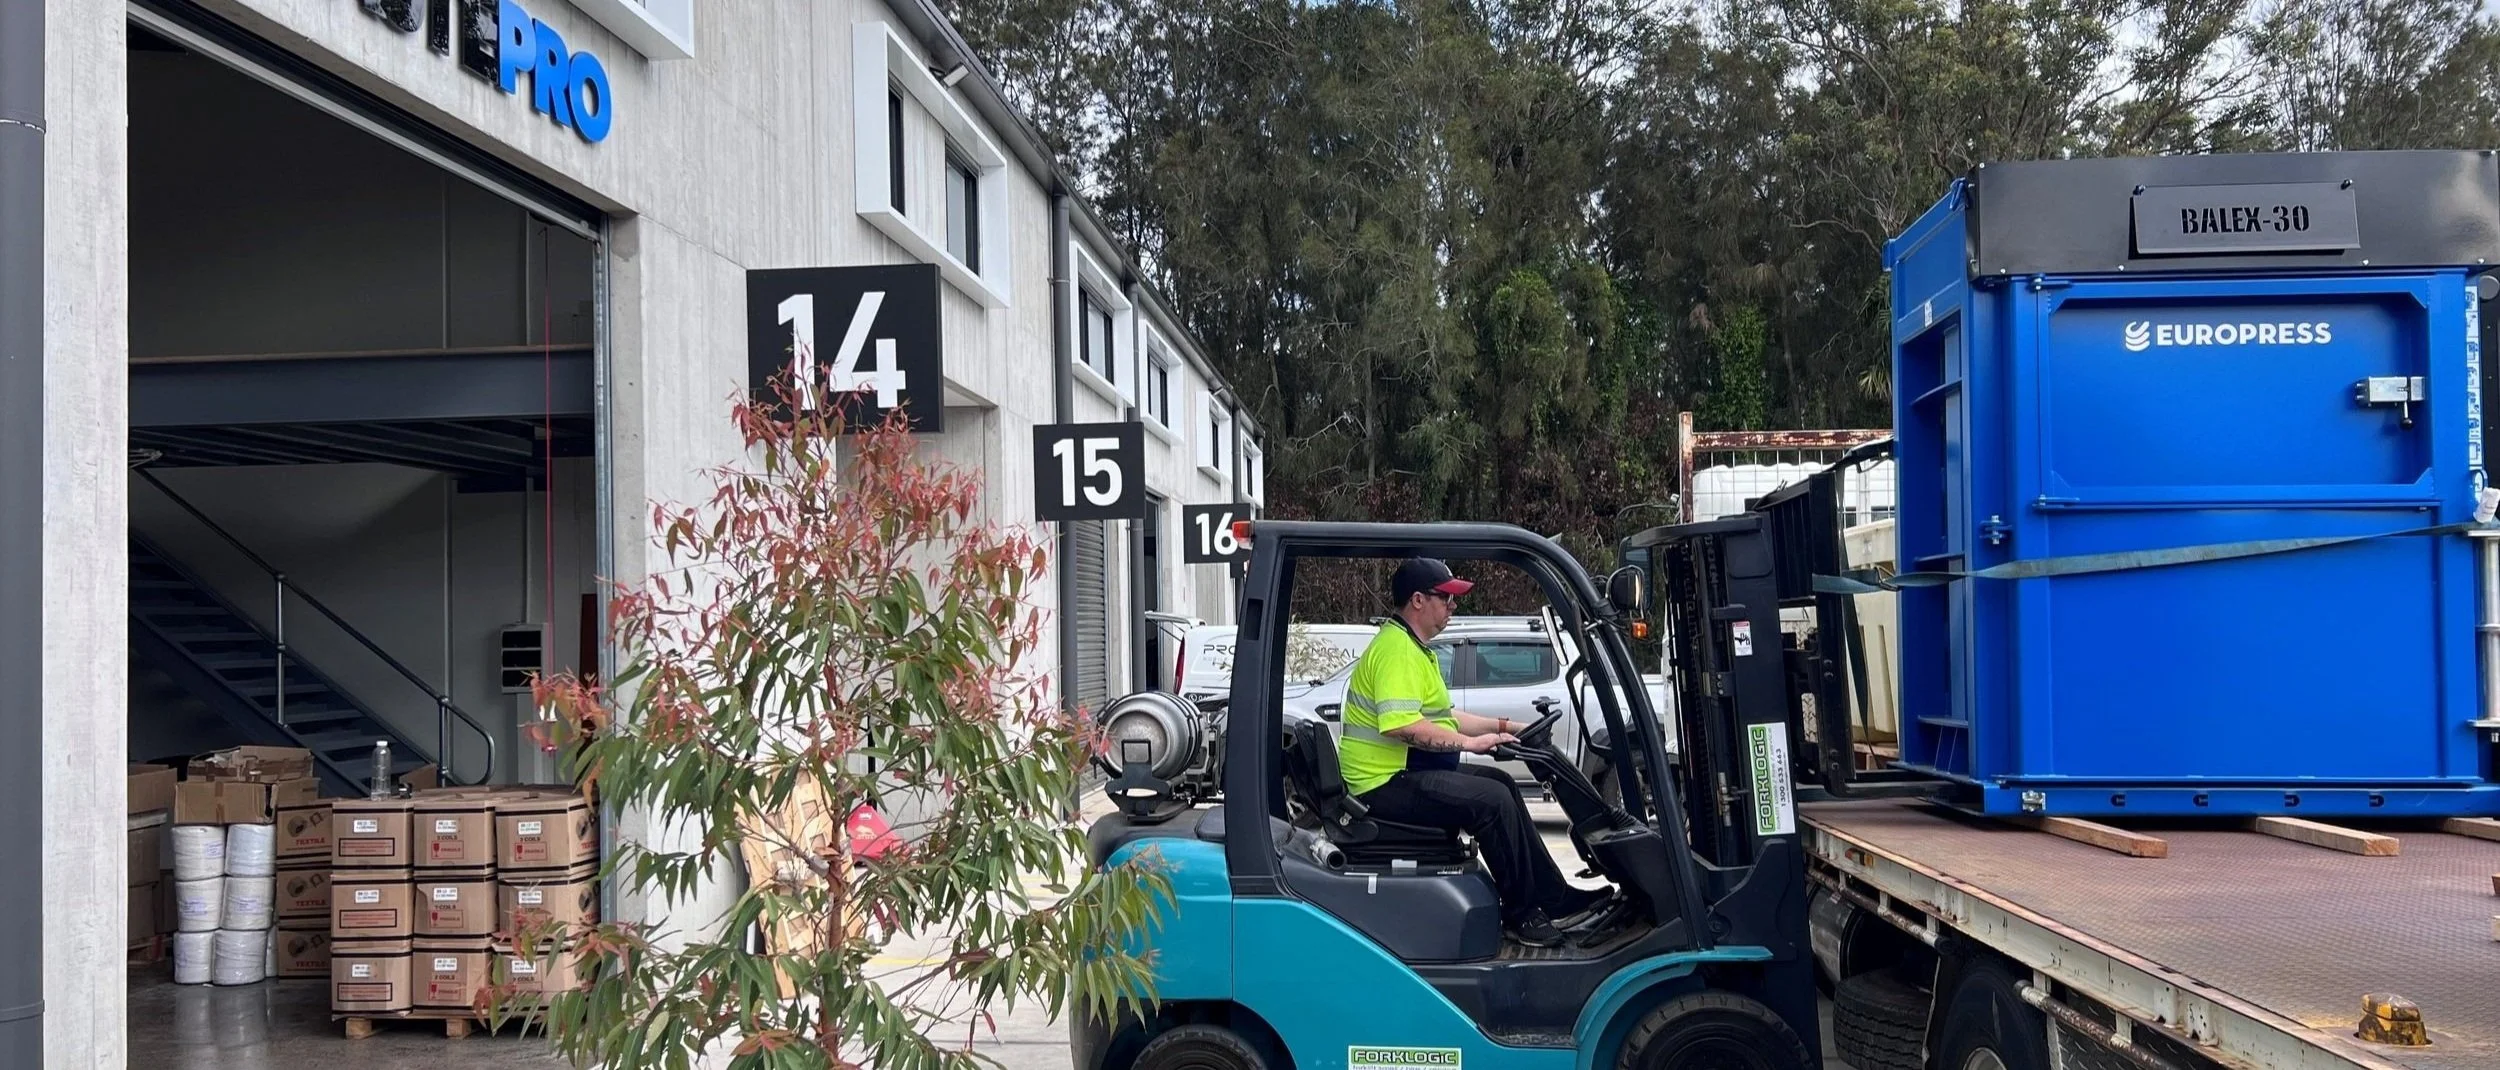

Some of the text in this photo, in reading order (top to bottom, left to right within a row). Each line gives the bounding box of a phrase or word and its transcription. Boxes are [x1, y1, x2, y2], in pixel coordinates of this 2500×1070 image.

[2181, 205, 2310, 234] BALEX-30
[777, 291, 906, 411] 14
[2156, 322, 2332, 346] EUROPRESS
[1052, 437, 1122, 507] 15
[1195, 512, 1238, 555] 16
[1354, 1051, 1455, 1063] FORKLOGIC
